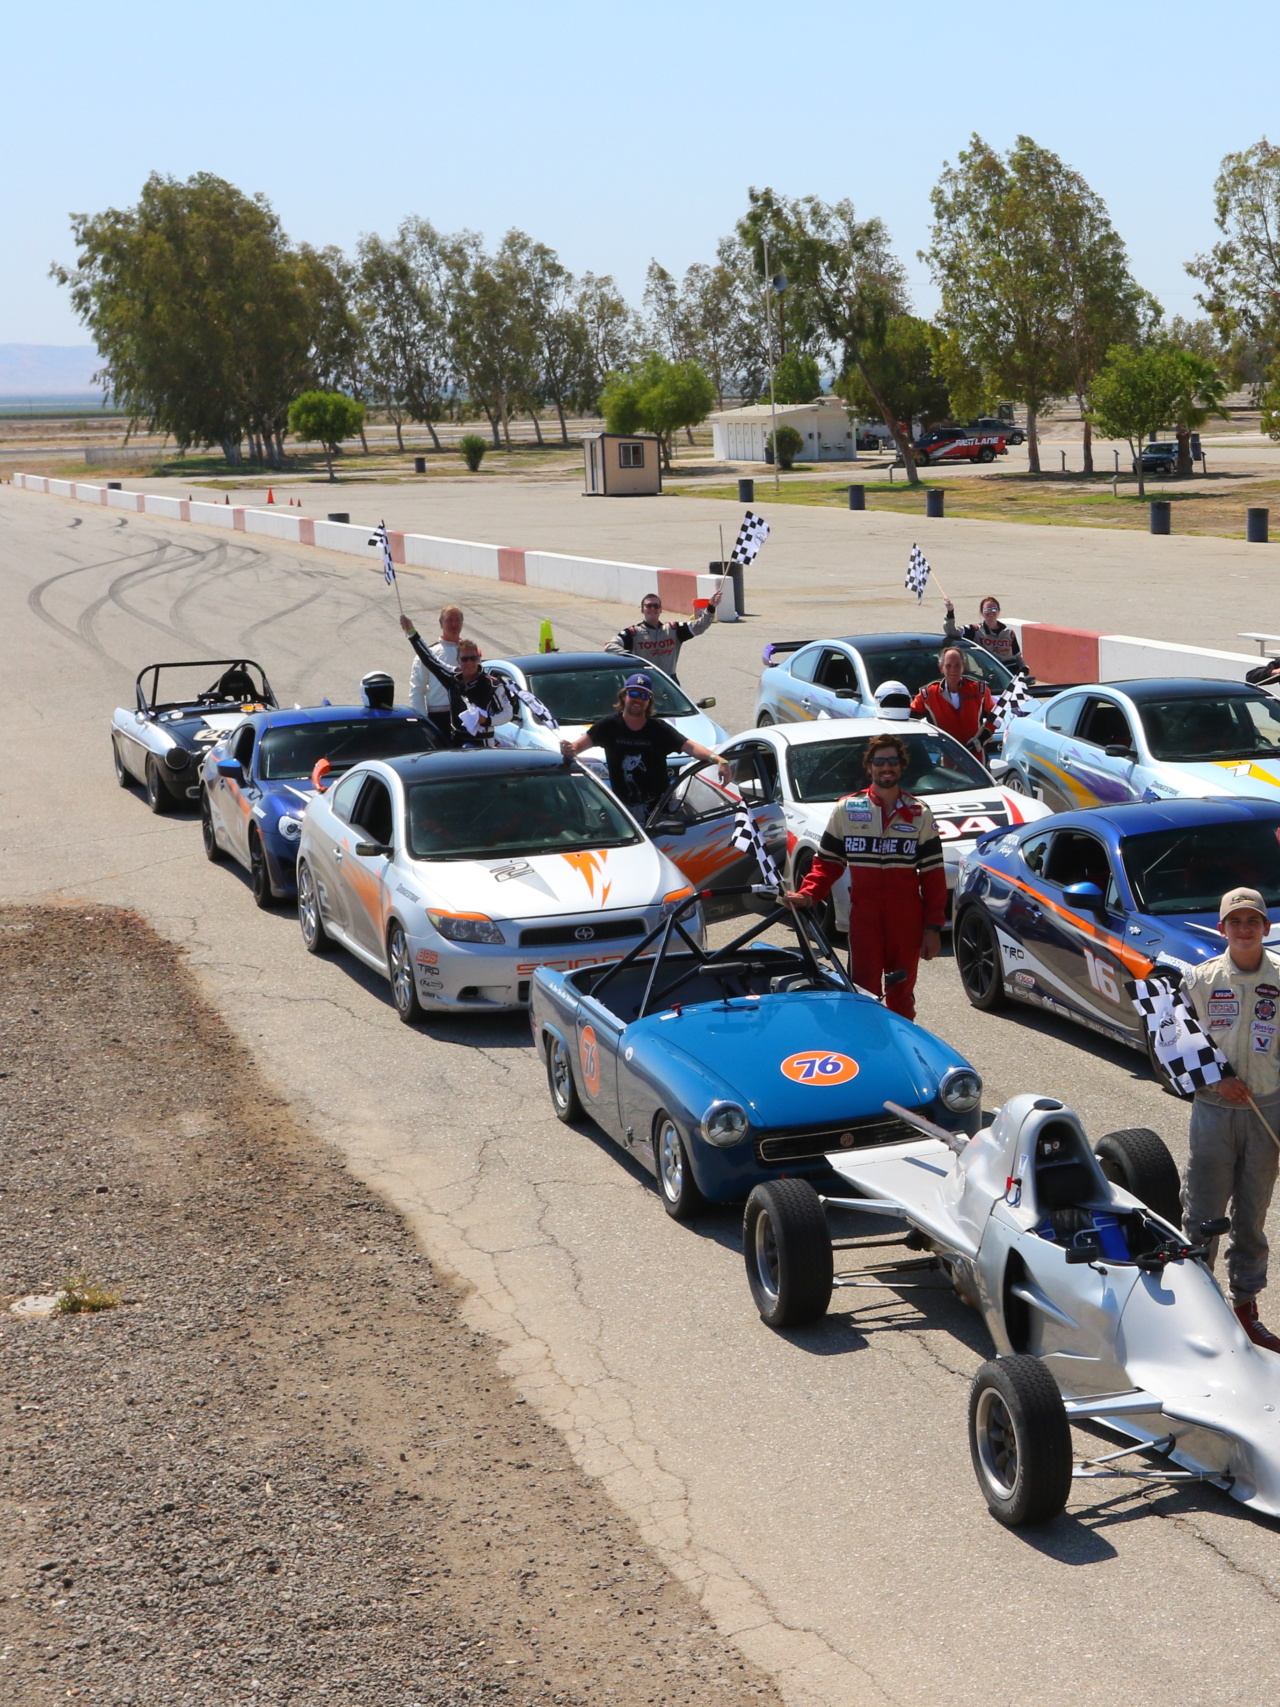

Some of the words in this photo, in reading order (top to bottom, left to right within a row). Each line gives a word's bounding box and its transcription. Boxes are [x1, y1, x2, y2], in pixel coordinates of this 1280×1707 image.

[638, 638, 675, 650] TOYOTA
[845, 837, 866, 852] RED
[903, 839, 917, 855] OIL
[490, 862, 535, 882] 2
[417, 949, 438, 964] BBS
[1002, 944, 1025, 961] TRD
[417, 963, 440, 976] TRD
[1083, 947, 1121, 1004] 16
[583, 1042, 596, 1081] 76
[794, 1054, 843, 1080] 76
